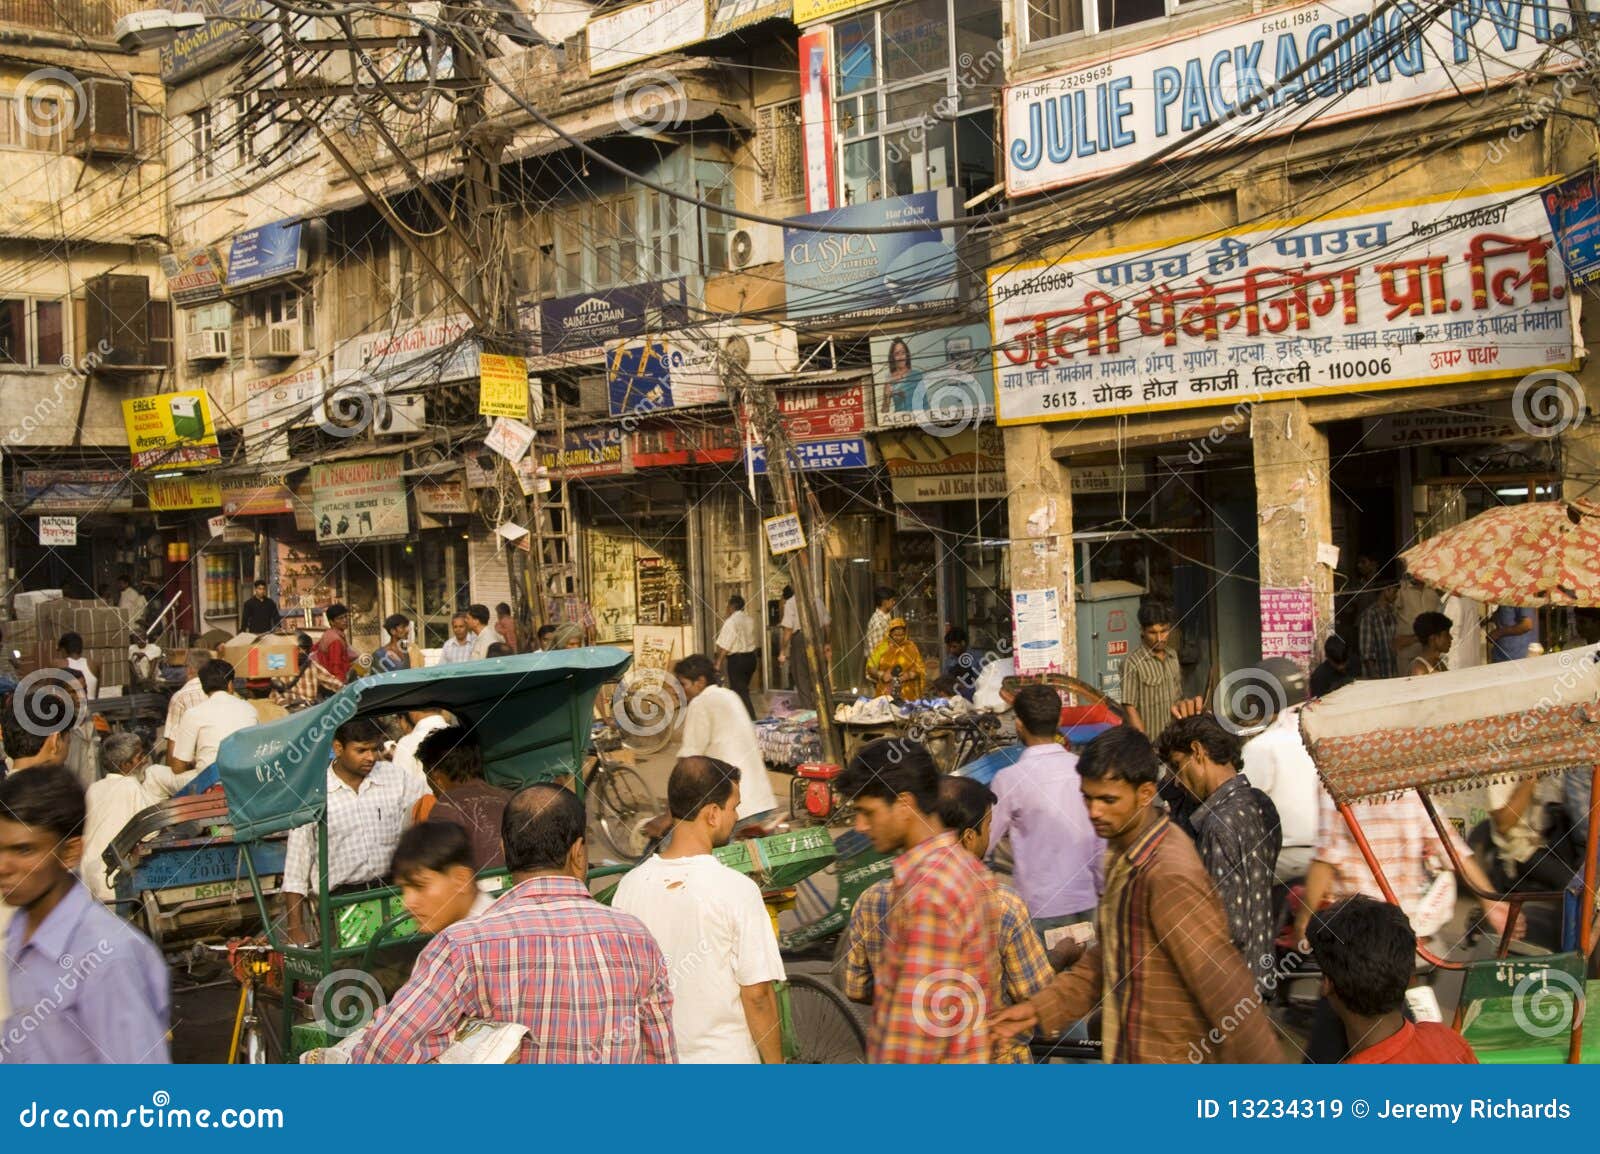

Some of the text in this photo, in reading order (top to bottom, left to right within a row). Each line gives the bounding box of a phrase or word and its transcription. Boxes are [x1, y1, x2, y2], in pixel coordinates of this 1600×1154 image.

[1292, 10, 1320, 27] 1983
[1010, 75, 1136, 171] JULIE
[1153, 2, 1425, 137] PACKAGING
[1015, 65, 1114, 101] PH OFF 23269695
[1096, 221, 1392, 286] पाउच ही पाउच
[1003, 290, 1123, 369] जूली
[1133, 261, 1361, 346] पैकेजिंग
[1252, 360, 1311, 388] दिल्ली
[750, 442, 859, 461] KCHEN
